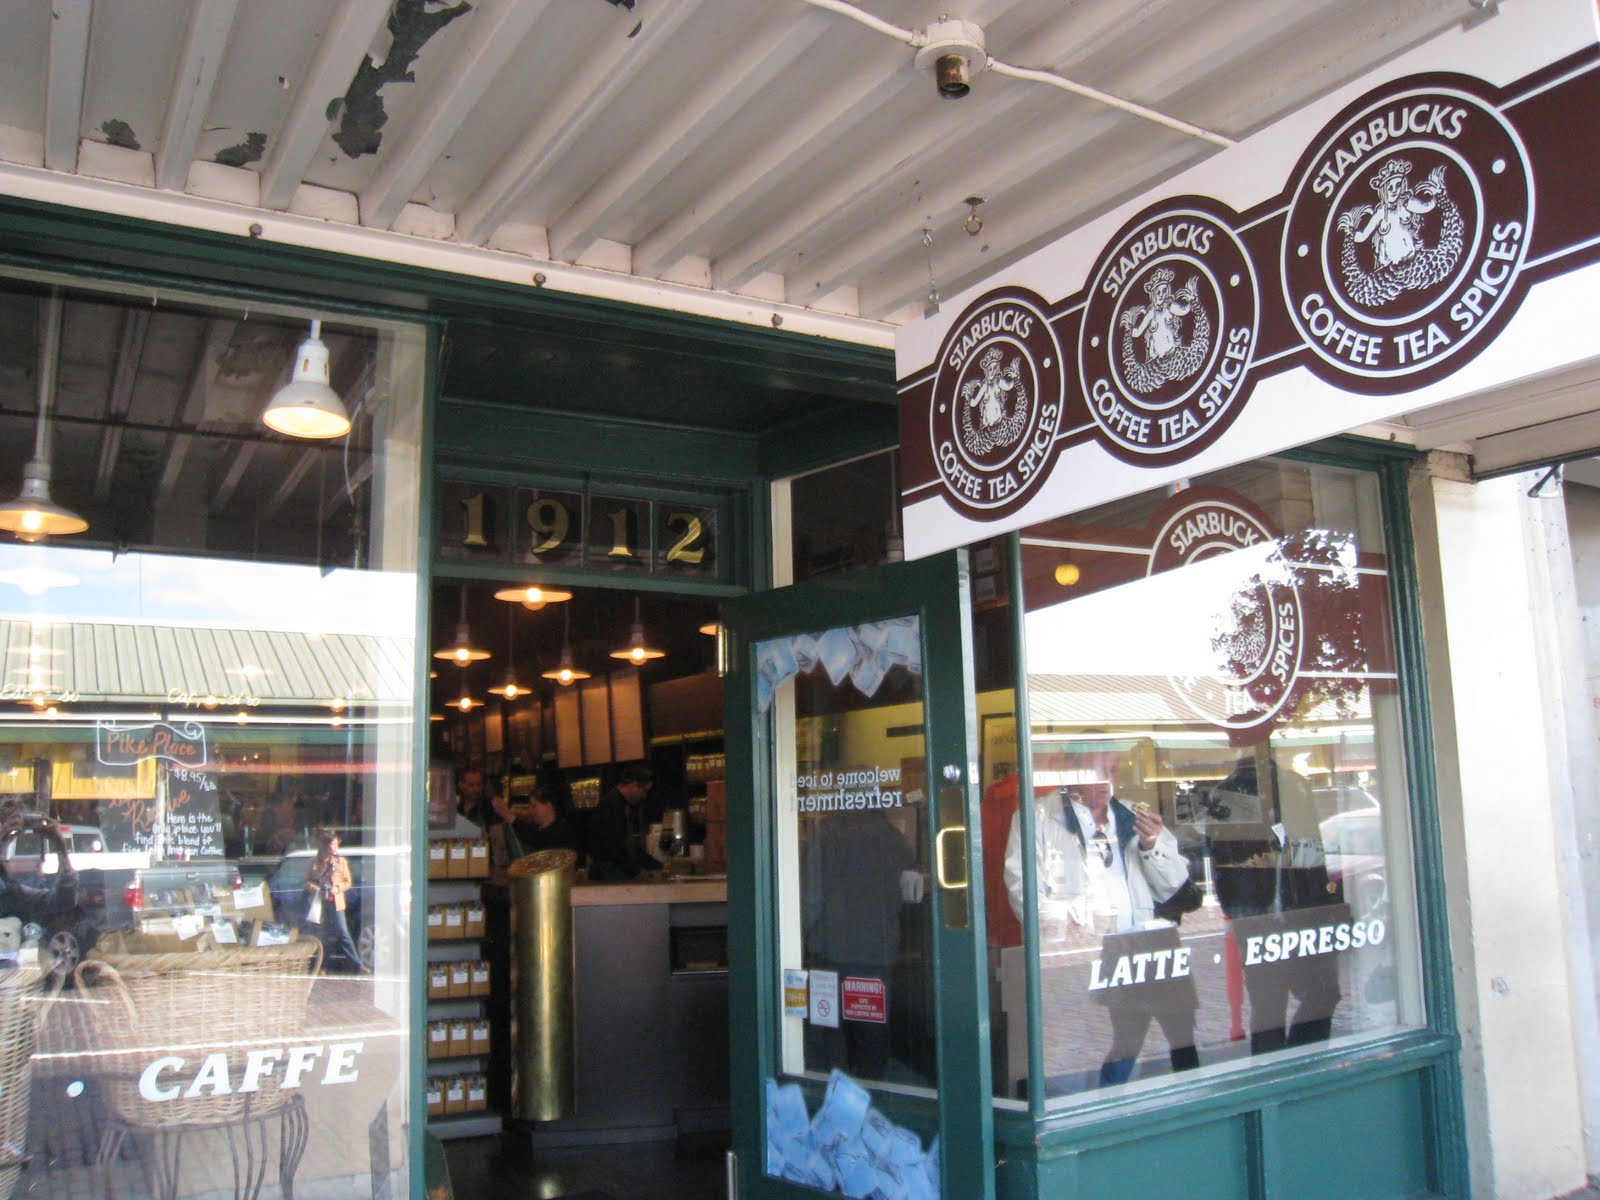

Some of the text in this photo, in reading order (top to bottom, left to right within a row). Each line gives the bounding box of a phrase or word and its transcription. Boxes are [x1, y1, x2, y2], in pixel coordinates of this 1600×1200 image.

[1312, 103, 1468, 199] STARBUCKS
[1102, 223, 1214, 299] STARBUCKS
[1300, 220, 1523, 366] COFFEE TEA SPICES
[949, 309, 1033, 372] STARBUCKS
[1092, 326, 1250, 444] COFFEE TEA SPICES
[939, 403, 1058, 500] COFFEE TEA SPICES
[461, 492, 705, 564] 1912
[1169, 511, 1260, 556] STARBUCK
[1270, 602, 1296, 683] SPICES
[106, 730, 197, 755] Pike Place
[135, 831, 154, 845] find
[202, 834, 213, 846] of
[166, 812, 213, 824] Here is the
[173, 824, 198, 836] place
[200, 822, 222, 837] you'll
[1087, 946, 1192, 991] LATTE
[1244, 918, 1386, 966] ESPRESSO
[138, 1041, 365, 1103] CAFFE
